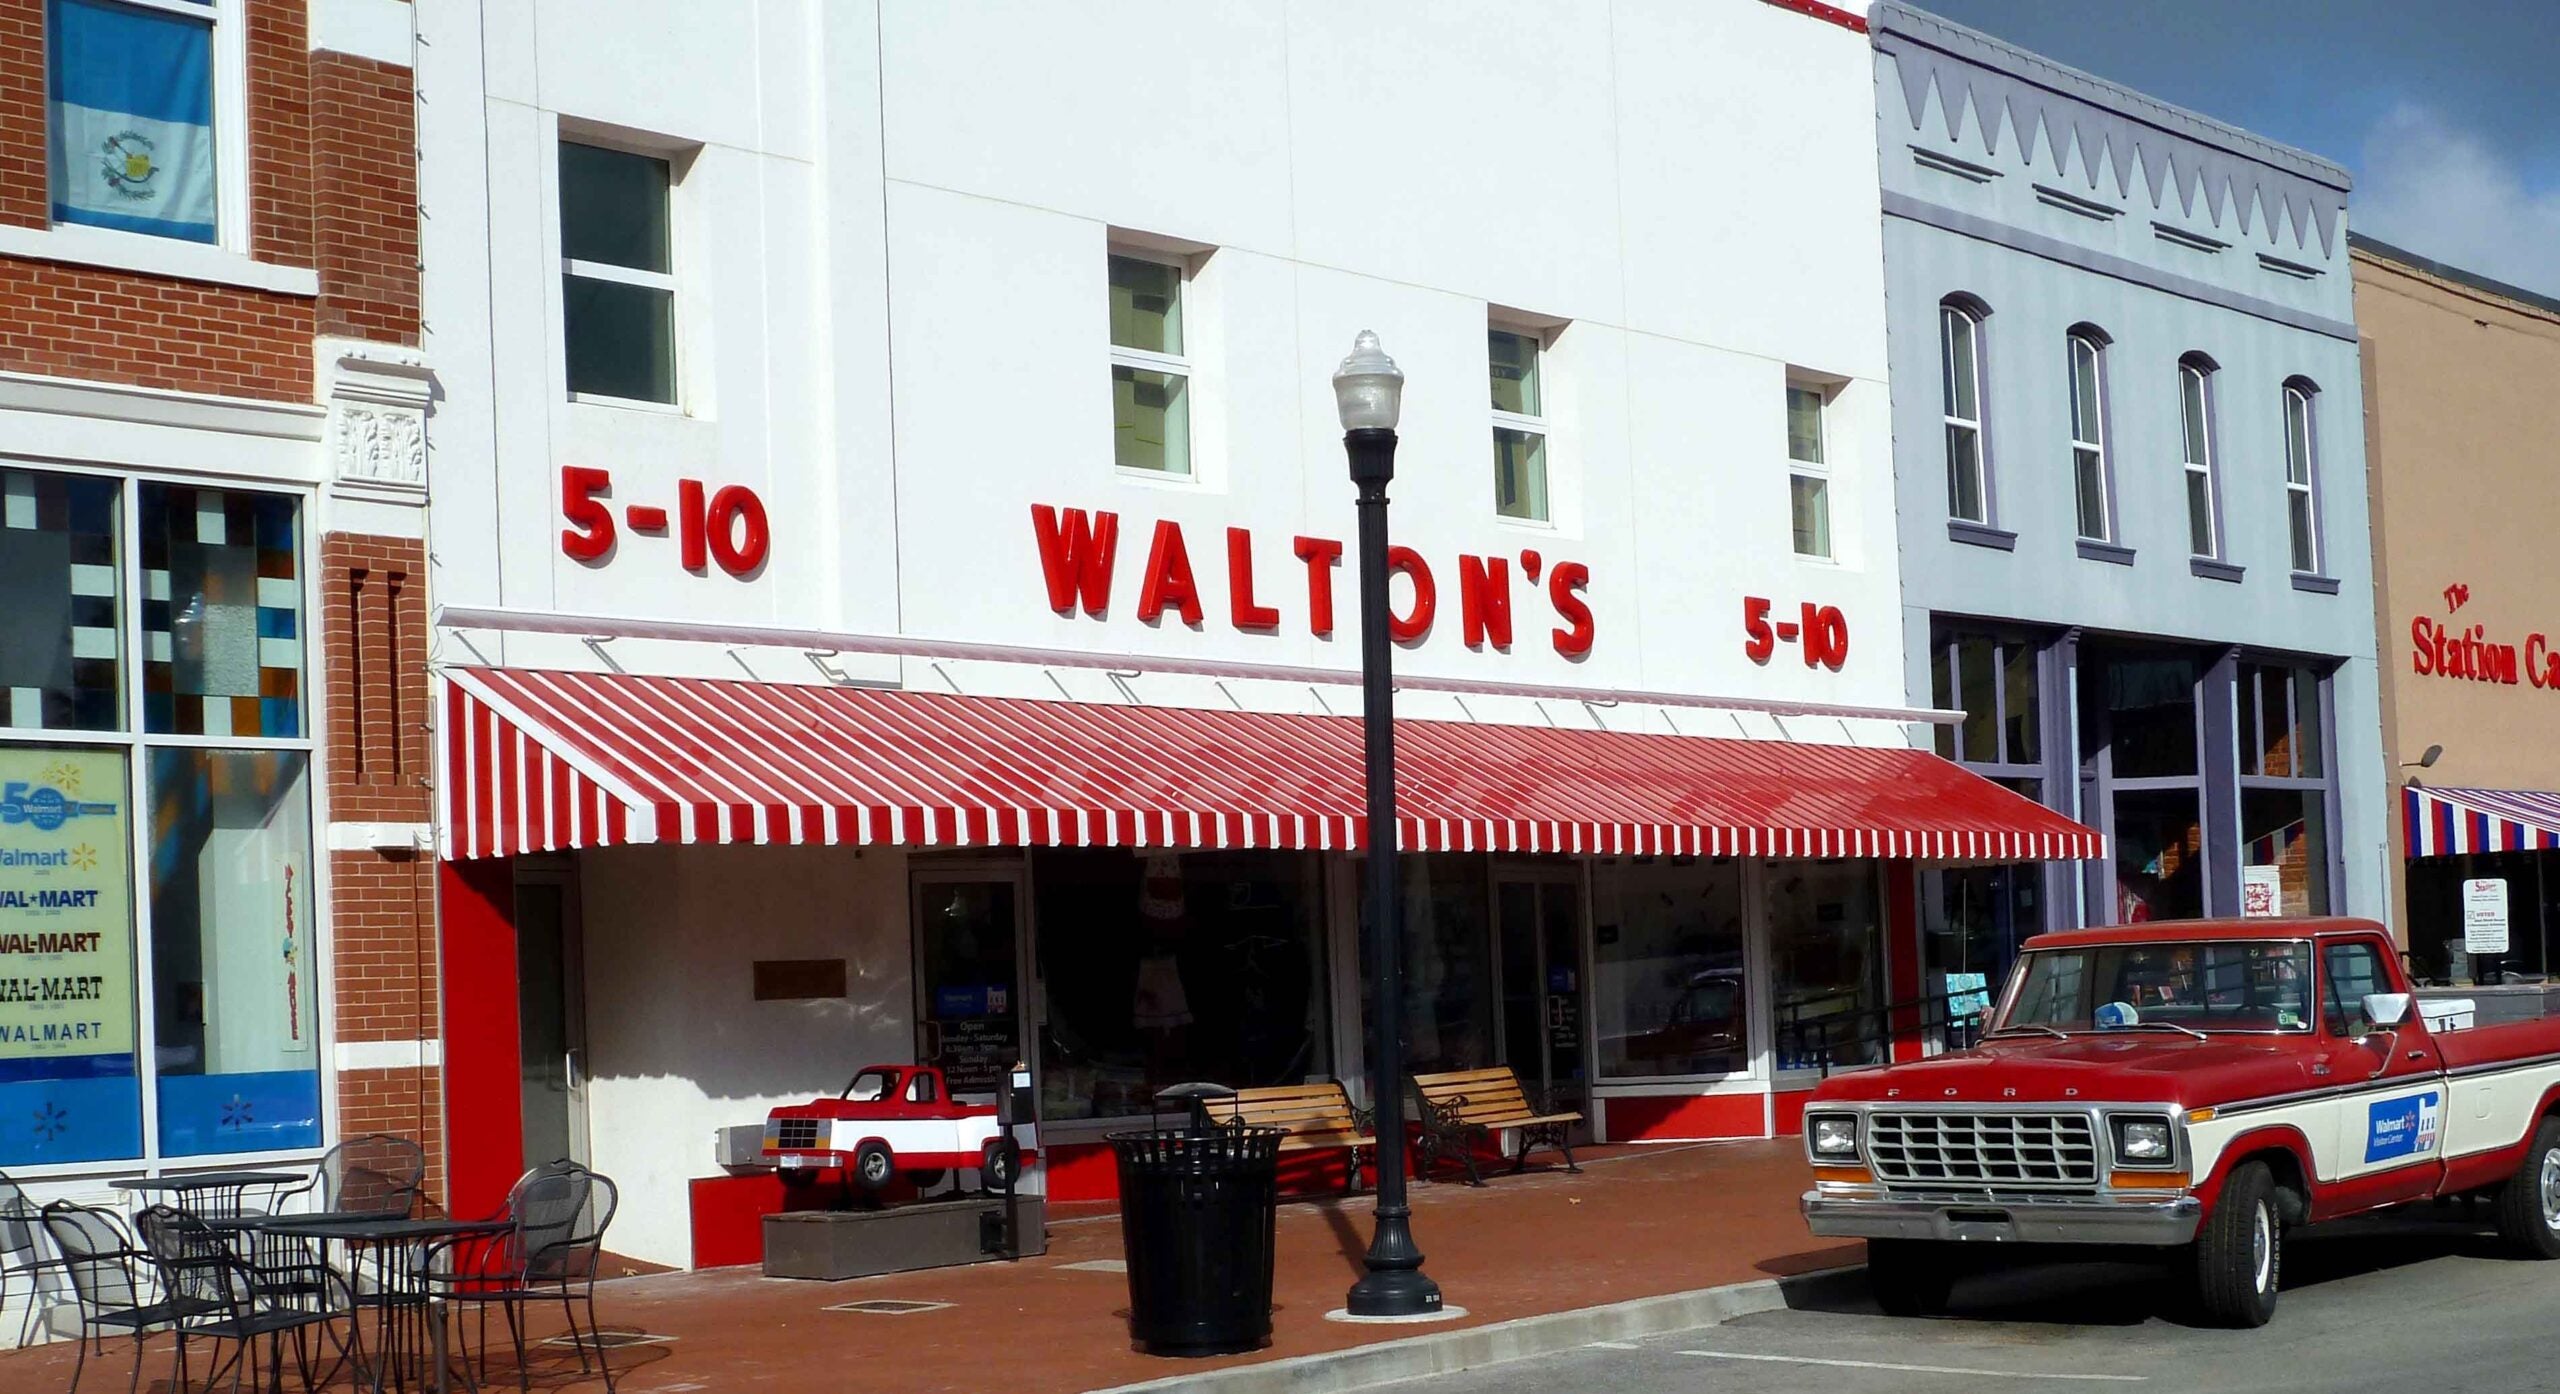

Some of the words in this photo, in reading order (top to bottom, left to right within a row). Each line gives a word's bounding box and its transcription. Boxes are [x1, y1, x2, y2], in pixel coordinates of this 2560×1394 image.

[562, 464, 769, 575] 5-10
[1031, 502, 1595, 657] WALTON'S
[2443, 583, 2469, 614] The
[1744, 596, 1849, 670] 5-10
[2412, 615, 2518, 685] Station
[23, 804, 63, 814] Walmart
[0, 848, 69, 867] almart
[2375, 1115, 2405, 1135] Walmart
